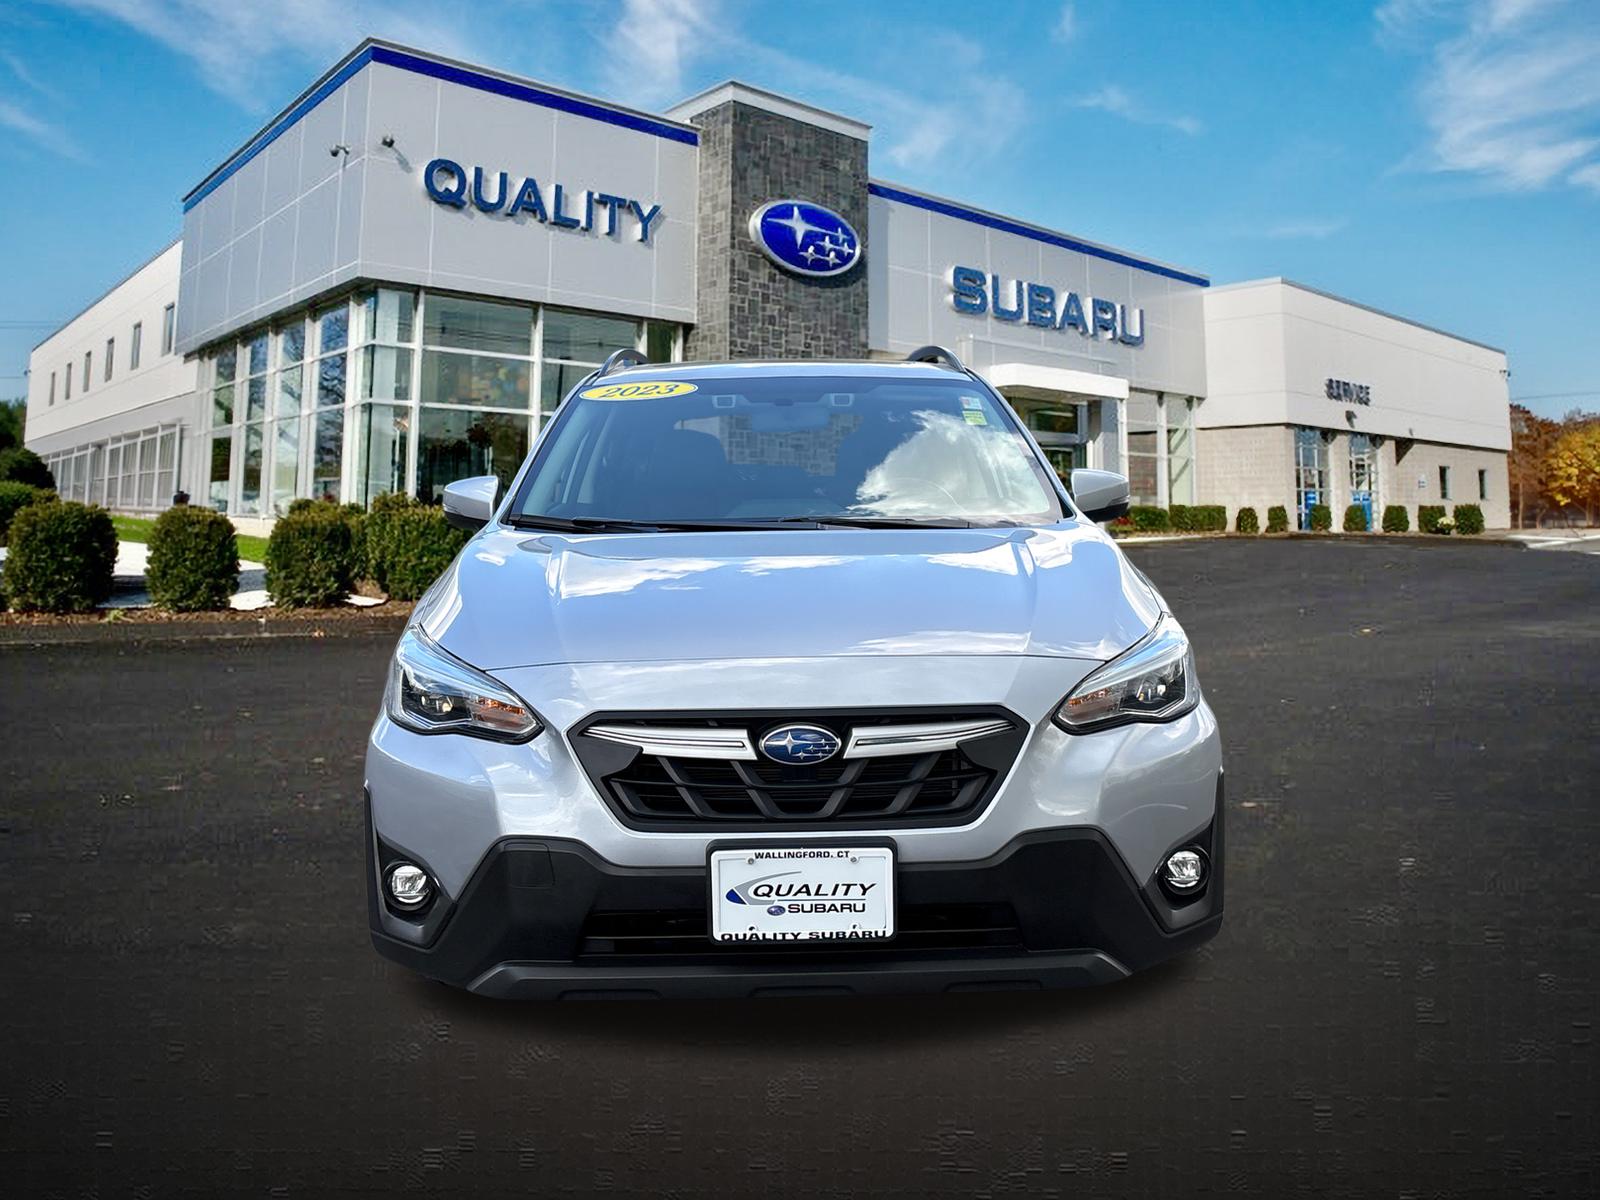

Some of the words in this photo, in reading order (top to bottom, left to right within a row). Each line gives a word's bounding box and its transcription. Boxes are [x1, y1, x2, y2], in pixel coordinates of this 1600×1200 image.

[423, 158, 663, 243] QUALITY
[950, 265, 1146, 347] SUBARU
[599, 384, 680, 398] 2023
[1325, 378, 1370, 406] SERVICE
[837, 850, 850, 858] CT
[753, 883, 877, 897] QUALITY
[788, 903, 866, 913] SUBARU
[721, 932, 801, 941] QUALITY
[808, 930, 887, 940] SUBARU
